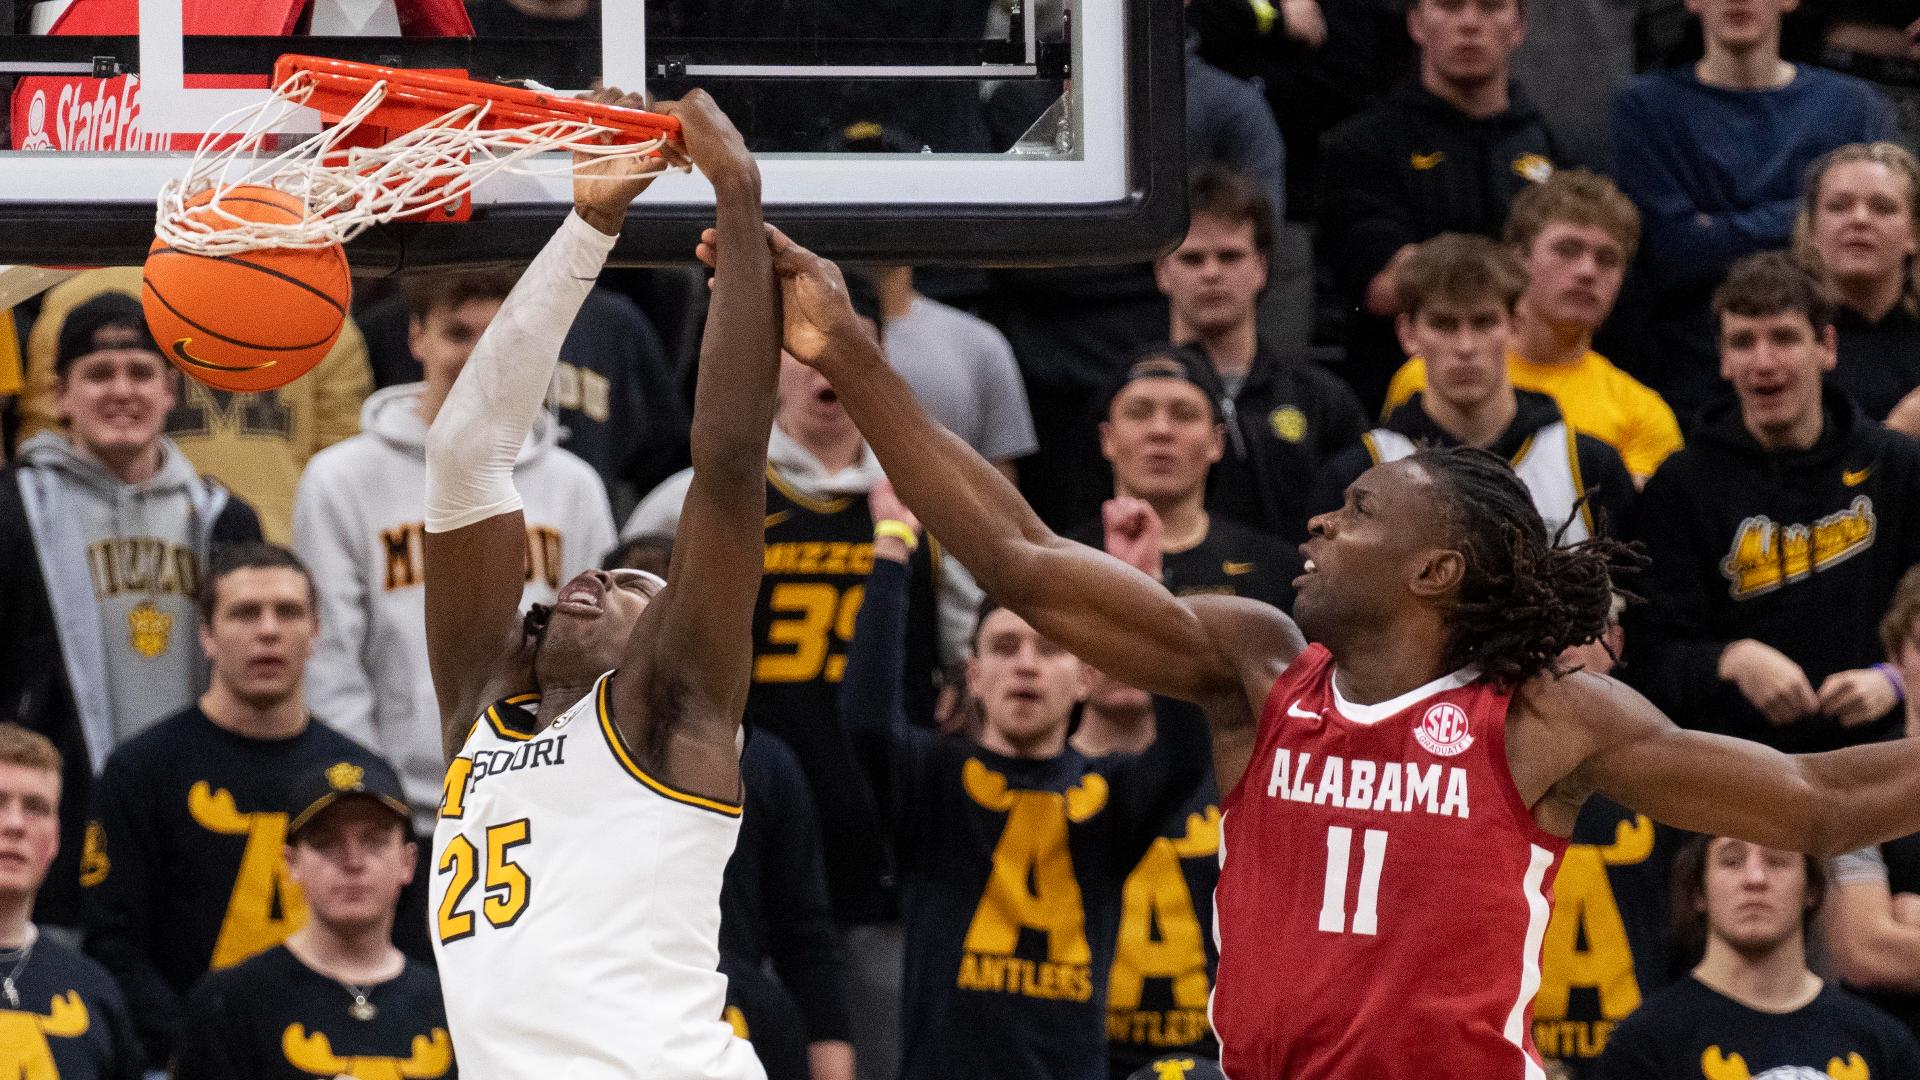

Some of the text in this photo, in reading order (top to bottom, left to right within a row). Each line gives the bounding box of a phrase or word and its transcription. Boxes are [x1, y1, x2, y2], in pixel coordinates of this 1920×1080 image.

[1419, 735, 1466, 755] GRADUATE
[1427, 705, 1465, 743] SEC
[1267, 748, 1470, 819] ALABAMA
[438, 818, 531, 946] 25
[964, 789, 1091, 962] A
[1106, 836, 1209, 1010] A
[1318, 825, 1389, 935] 11
[957, 953, 1093, 1002] ANTLERS
[1535, 844, 1642, 1021] A
